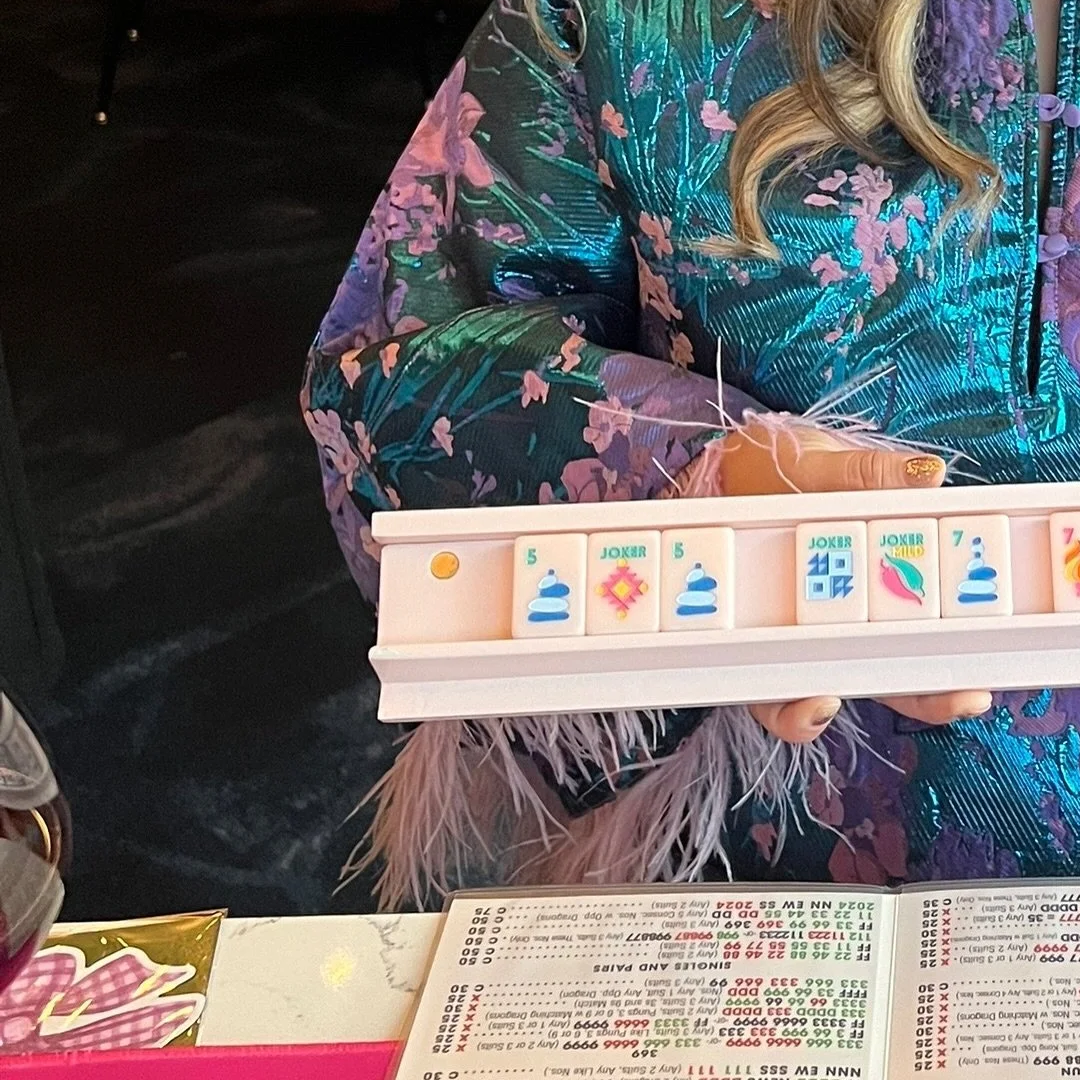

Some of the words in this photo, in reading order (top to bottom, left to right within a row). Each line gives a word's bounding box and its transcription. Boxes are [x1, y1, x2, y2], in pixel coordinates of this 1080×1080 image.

[879, 532, 924, 546] JOKER
[952, 530, 964, 547] 7
[1063, 527, 1075, 545] 7
[808, 535, 852, 549] JOKER
[600, 546, 647, 560] JOKER
[673, 542, 684, 559] 5
[527, 548, 538, 565] 5
[760, 901, 775, 909] SS
[782, 901, 803, 909] EW
[810, 901, 831, 909] NN
[839, 902, 874, 910] 2024
[941, 958, 949, 966] X
[1039, 954, 1064, 963] 999
[593, 964, 632, 972] PAIRS
[674, 962, 731, 970] SINGLES
[920, 959, 936, 968] 25
[916, 1027, 932, 1036] 30
[938, 1026, 946, 1034] X
[562, 1040, 598, 1050] 9999
[603, 1040, 639, 1049] 6666
[644, 1039, 670, 1048] 666
[675, 1038, 701, 1048] 333
[726, 1038, 761, 1047] 9999
[766, 1038, 801, 1047] 6666
[806, 1039, 832, 1048] 666
[838, 1040, 862, 1049] 333
[432, 1044, 451, 1053] 25
[456, 1044, 466, 1052] X
[632, 1050, 657, 1058] 369
[937, 1060, 946, 1068] X
[1033, 1056, 1059, 1065] 999
[688, 1066, 714, 1075] 111
[725, 1065, 750, 1074] 111
[760, 1066, 787, 1075] SSS
[794, 1066, 818, 1075] EW
[914, 1061, 932, 1071] 25
[424, 1072, 442, 1080] 30
[826, 1067, 860, 1077] NNN
